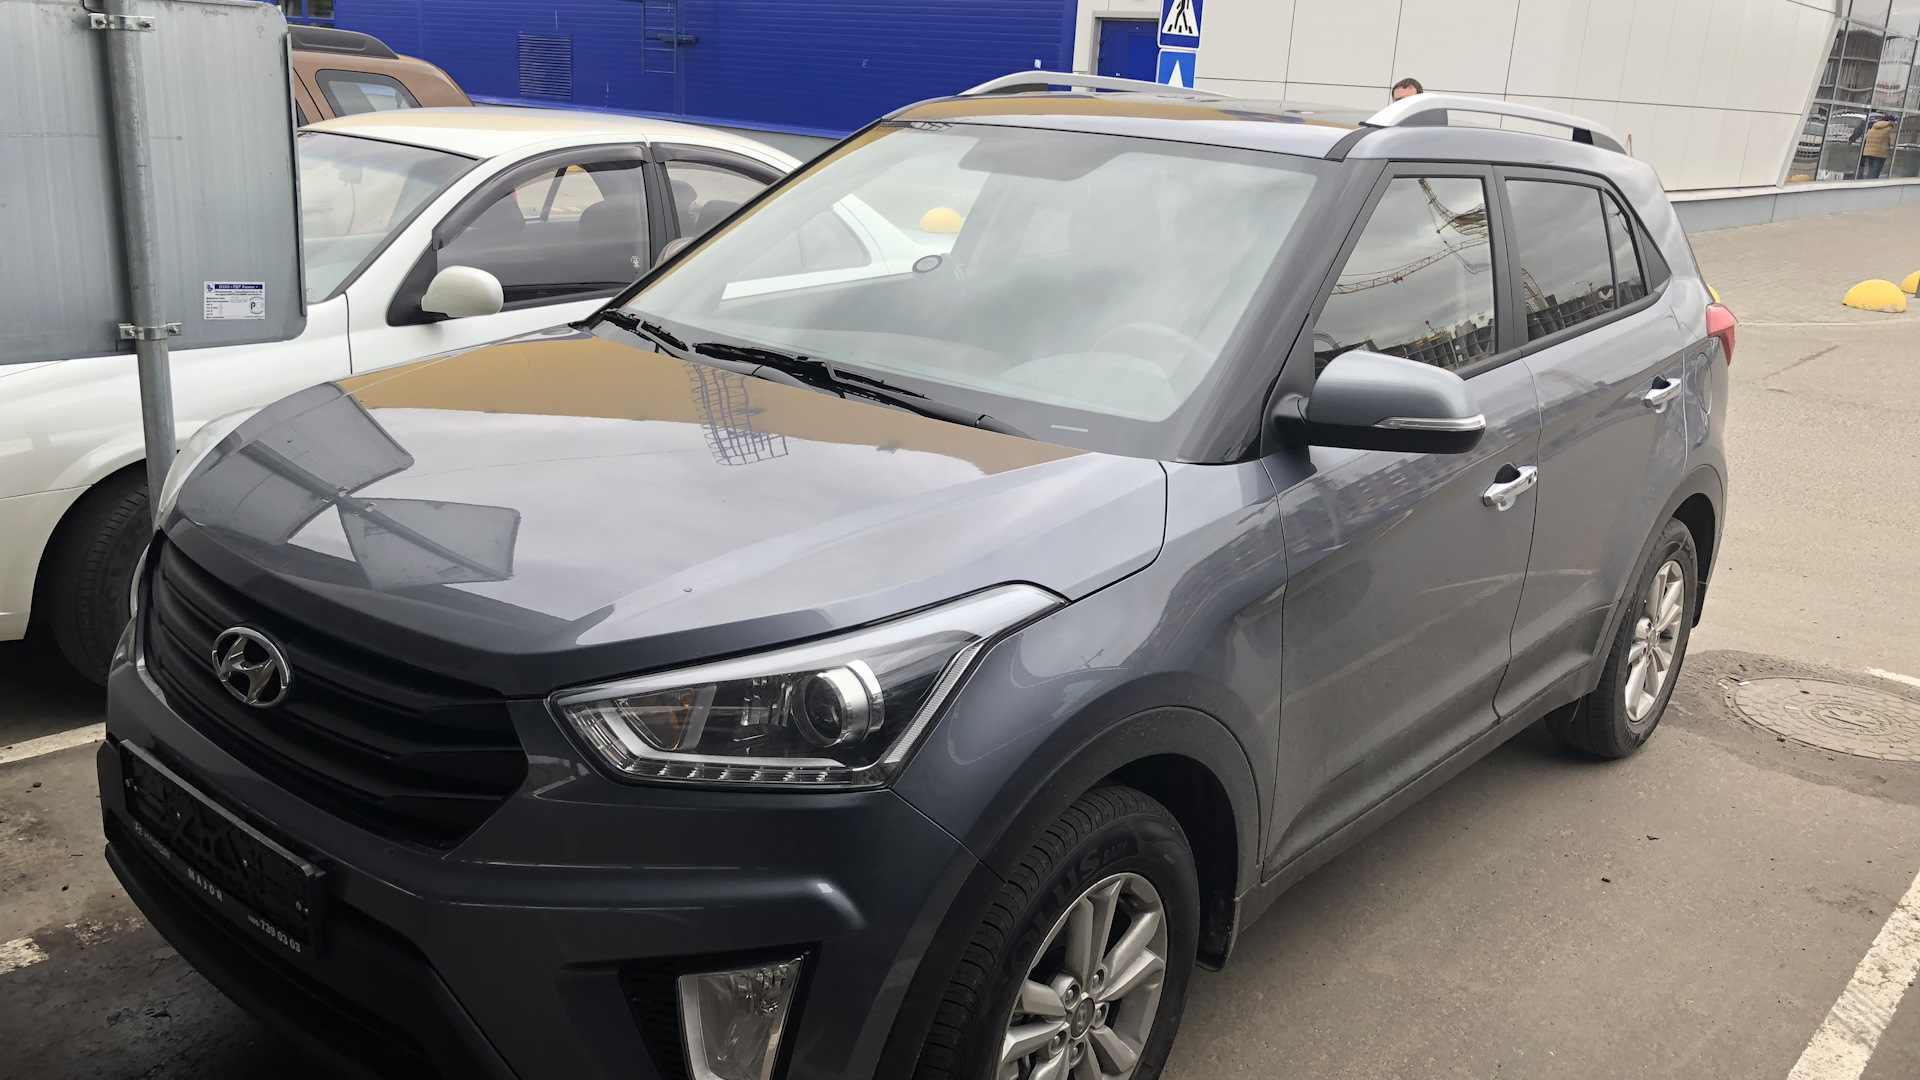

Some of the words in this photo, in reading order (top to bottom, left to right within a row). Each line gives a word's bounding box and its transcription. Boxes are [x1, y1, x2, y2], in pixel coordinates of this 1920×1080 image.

[187, 867, 224, 902] MAJOR
[260, 919, 276, 937] 739
[277, 930, 289, 946] 03
[289, 938, 302, 953] 03
